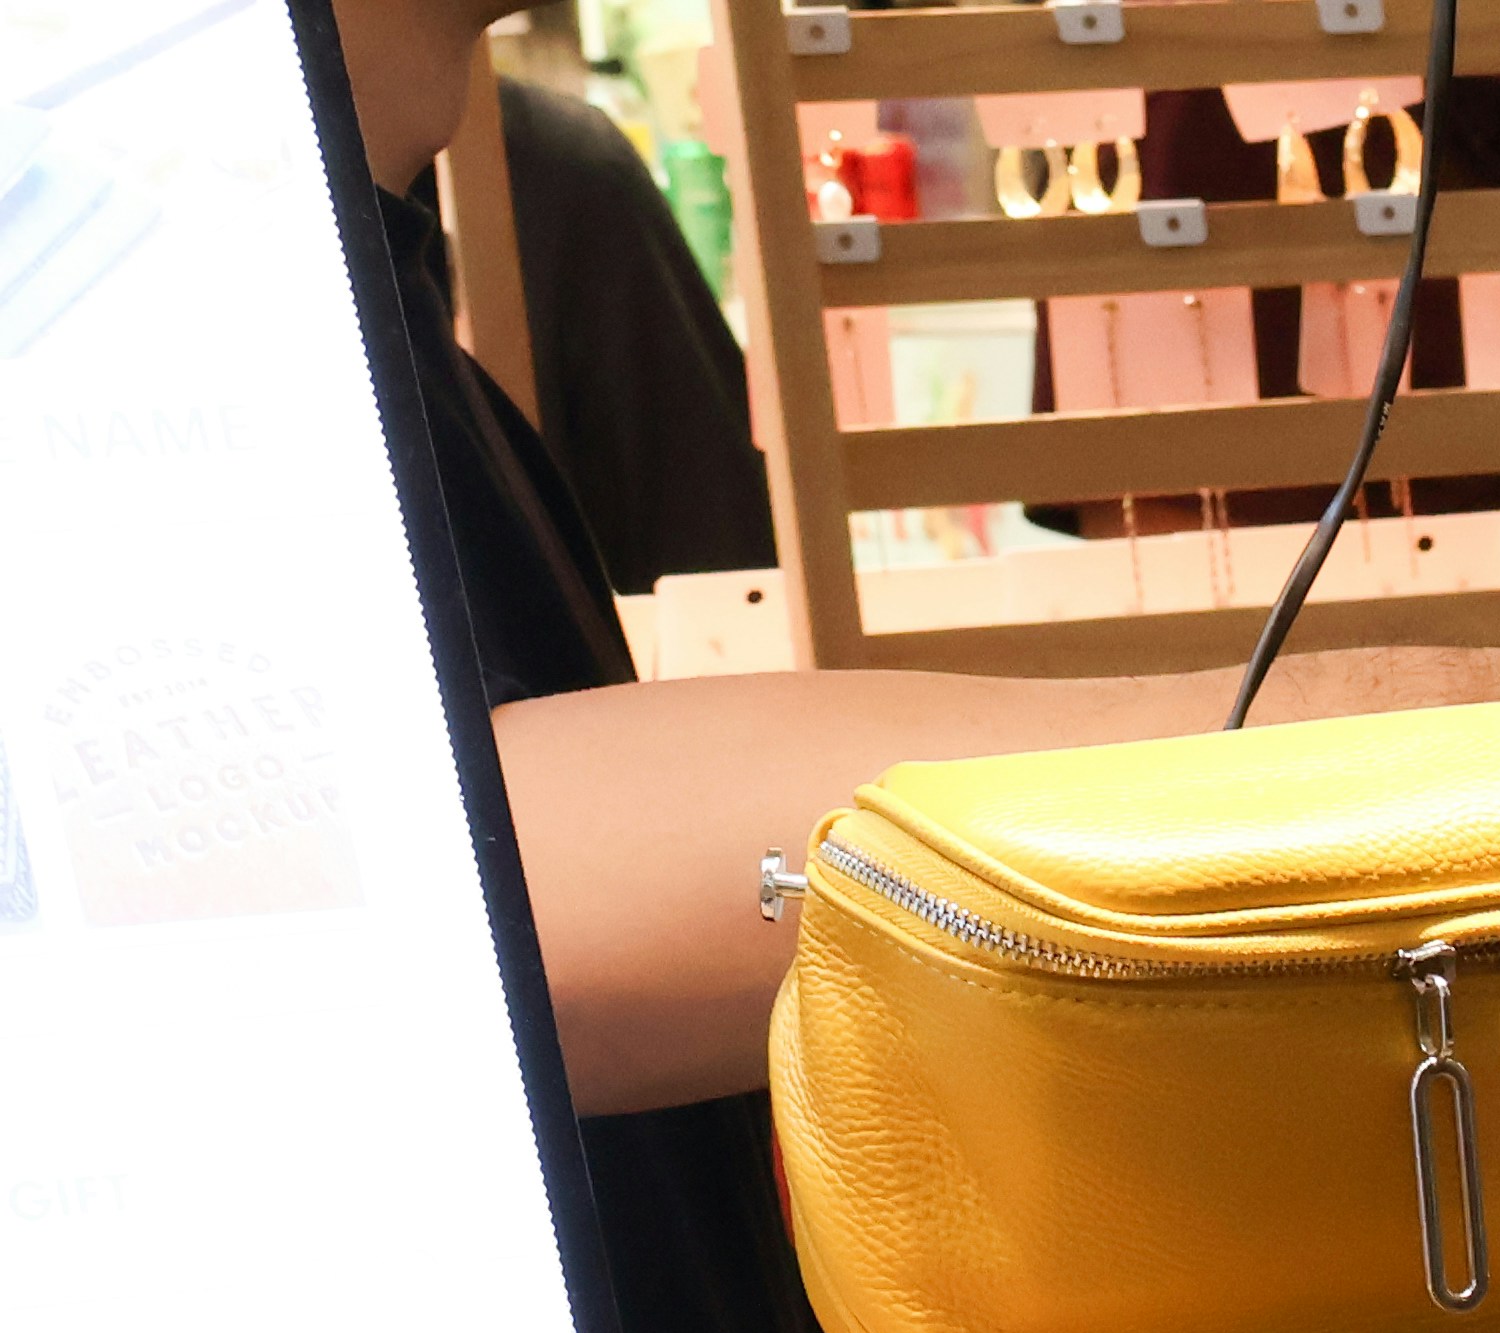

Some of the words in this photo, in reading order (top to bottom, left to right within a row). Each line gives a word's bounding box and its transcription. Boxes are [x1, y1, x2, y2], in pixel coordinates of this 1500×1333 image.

[43, 402, 257, 461] NAME
[44, 637, 272, 728] EMBOSSED
[51, 684, 326, 805] LEATHER
[145, 753, 286, 814] LOGO
[131, 784, 341, 870] MOCKUP
[9, 1172, 129, 1223] GIFT
